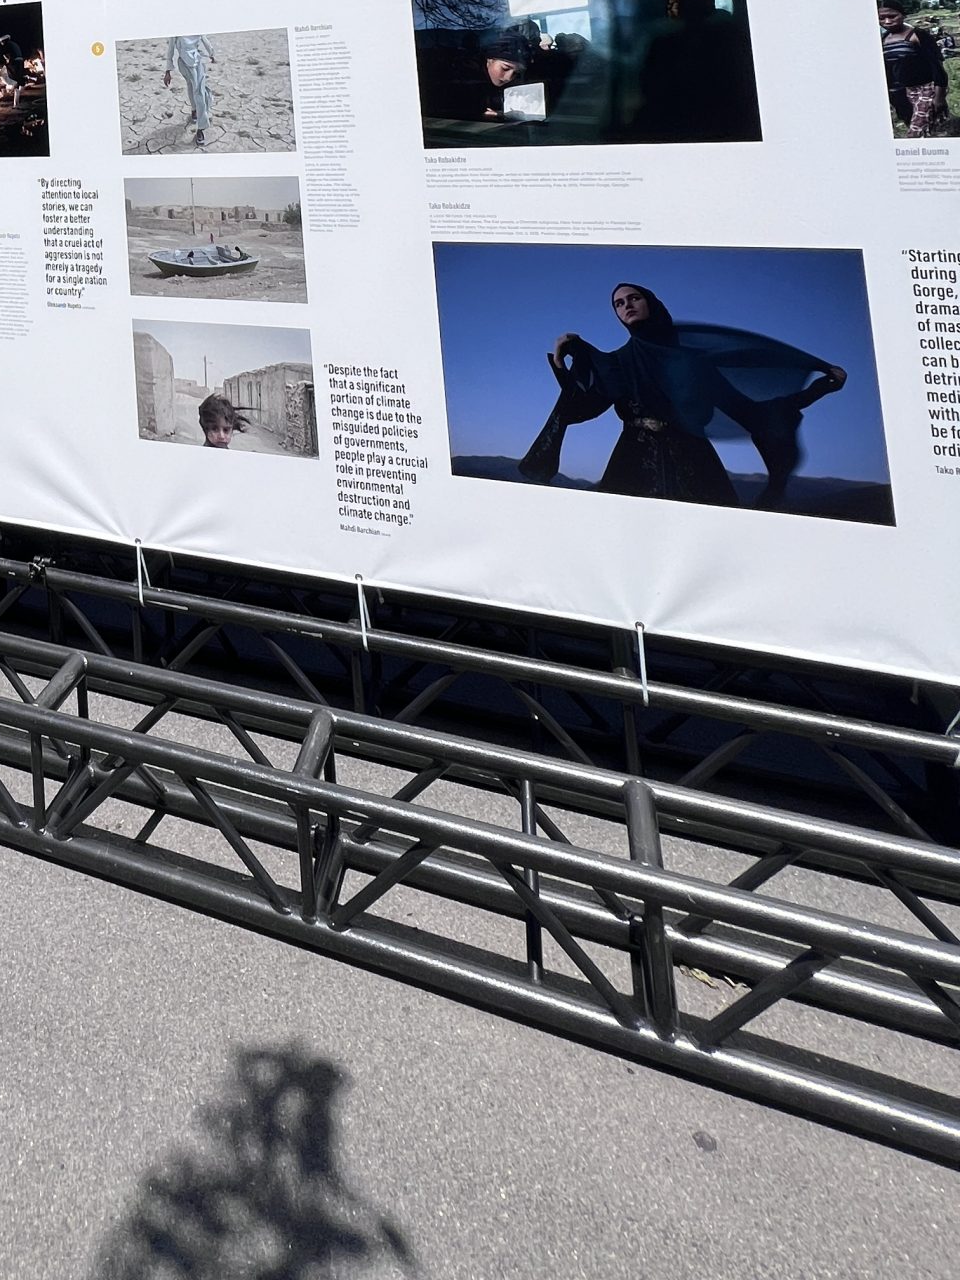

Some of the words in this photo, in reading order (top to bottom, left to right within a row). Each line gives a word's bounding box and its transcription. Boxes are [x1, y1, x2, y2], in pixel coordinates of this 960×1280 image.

[896, 148, 920, 156] Daniel
[38, 178, 48, 189] "By
[51, 178, 81, 189] directing
[42, 190, 71, 199] attention
[73, 191, 80, 199] to
[82, 190, 98, 199] local
[42, 202, 67, 212] stories,
[43, 214, 63, 223] foster
[70, 214, 90, 223] better
[44, 226, 93, 238] understanding
[44, 238, 57, 246] that
[65, 238, 82, 247] cruel
[84, 240, 94, 248] act
[96, 239, 102, 248] of
[45, 250, 82, 261] aggression
[84, 250, 90, 260] is
[92, 252, 103, 260] not
[46, 262, 68, 273] merely
[76, 263, 102, 274] tragedy
[911, 266, 957, 283] during
[46, 274, 55, 282] for
[63, 274, 83, 286] single
[85, 276, 107, 285] nation
[47, 287, 53, 295] or
[913, 284, 958, 300] Gorge,
[918, 318, 931, 331] of
[922, 356, 947, 367] can
[324, 364, 361, 377] "Despite
[363, 366, 378, 377] the
[380, 367, 398, 379] fact
[924, 371, 960, 386] detri
[329, 378, 347, 389] that
[349, 382, 354, 390] a
[356, 380, 405, 394] significant
[330, 393, 363, 404] portion
[366, 395, 374, 405] of
[376, 396, 410, 409] climate
[332, 406, 364, 420] change
[366, 409, 374, 419] is
[376, 410, 393, 421] due
[395, 412, 404, 422] to
[406, 413, 422, 424] the
[333, 420, 379, 434] misguided
[382, 425, 418, 438] policies
[931, 424, 947, 438] be
[334, 435, 342, 445] of
[344, 437, 407, 453] governments,
[335, 450, 364, 462] people
[367, 452, 385, 466] play
[388, 456, 393, 464] a
[396, 457, 428, 468] crucial
[336, 463, 353, 474] role
[355, 464, 364, 475] in
[366, 468, 416, 484] preventing
[935, 465, 954, 475] Tako
[337, 478, 403, 495] environmental
[338, 491, 390, 507] destruction
[393, 500, 410, 510] and
[339, 505, 372, 519] climate
[375, 510, 413, 526] change."
